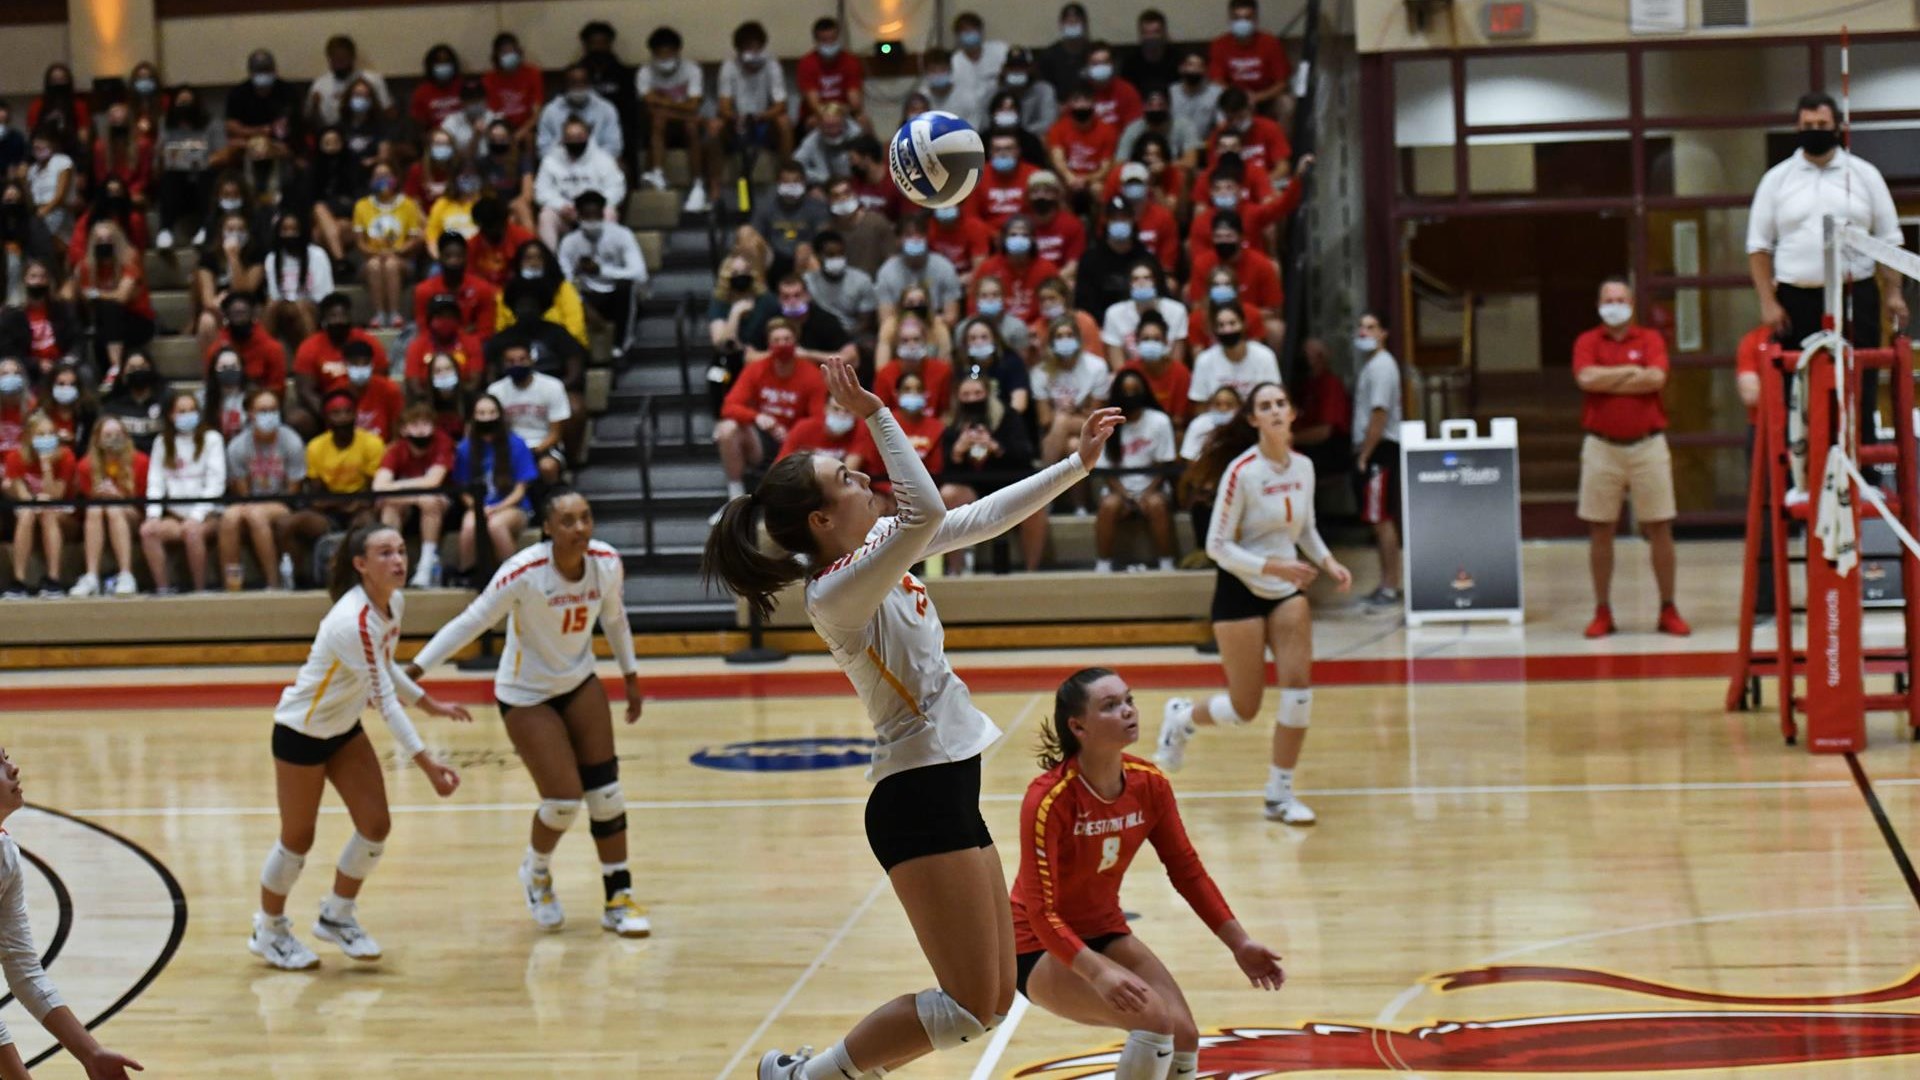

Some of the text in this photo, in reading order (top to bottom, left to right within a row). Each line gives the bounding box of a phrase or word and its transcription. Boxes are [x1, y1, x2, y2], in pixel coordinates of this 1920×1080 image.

[890, 140, 913, 192] molten
[561, 606, 588, 635] 15
[1097, 836, 1121, 874] 8
